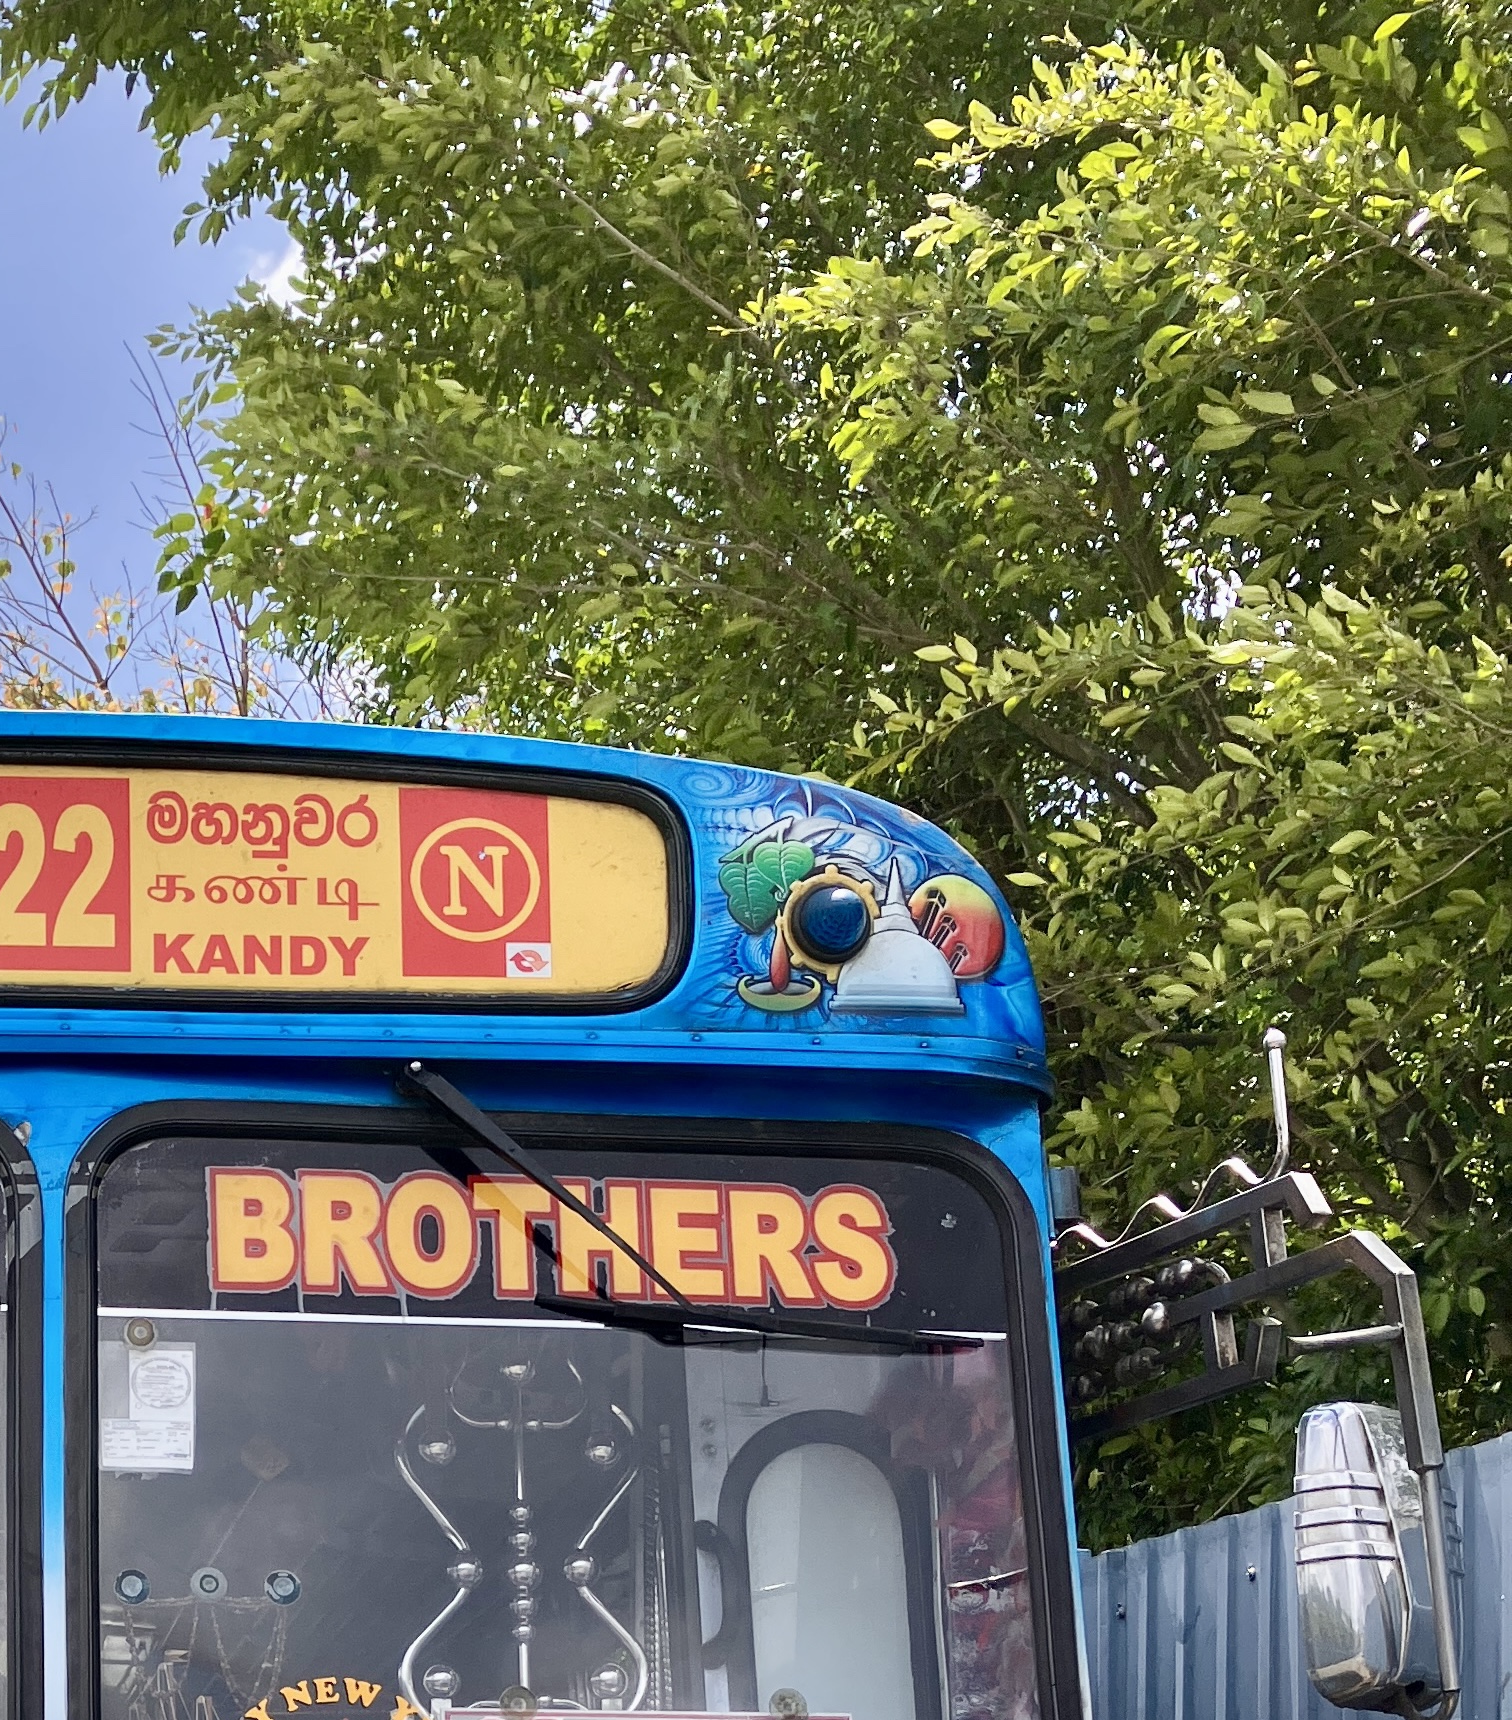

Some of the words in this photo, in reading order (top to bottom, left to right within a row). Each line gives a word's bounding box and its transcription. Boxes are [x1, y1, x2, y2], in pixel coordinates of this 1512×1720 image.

[146, 790, 379, 858] මහනුවර
[146, 863, 380, 921] கண்டி
[440, 845, 509, 917] N
[152, 933, 370, 976] KANDY
[205, 1166, 897, 1311] BROTHERS
[279, 1676, 382, 1713] NEW
